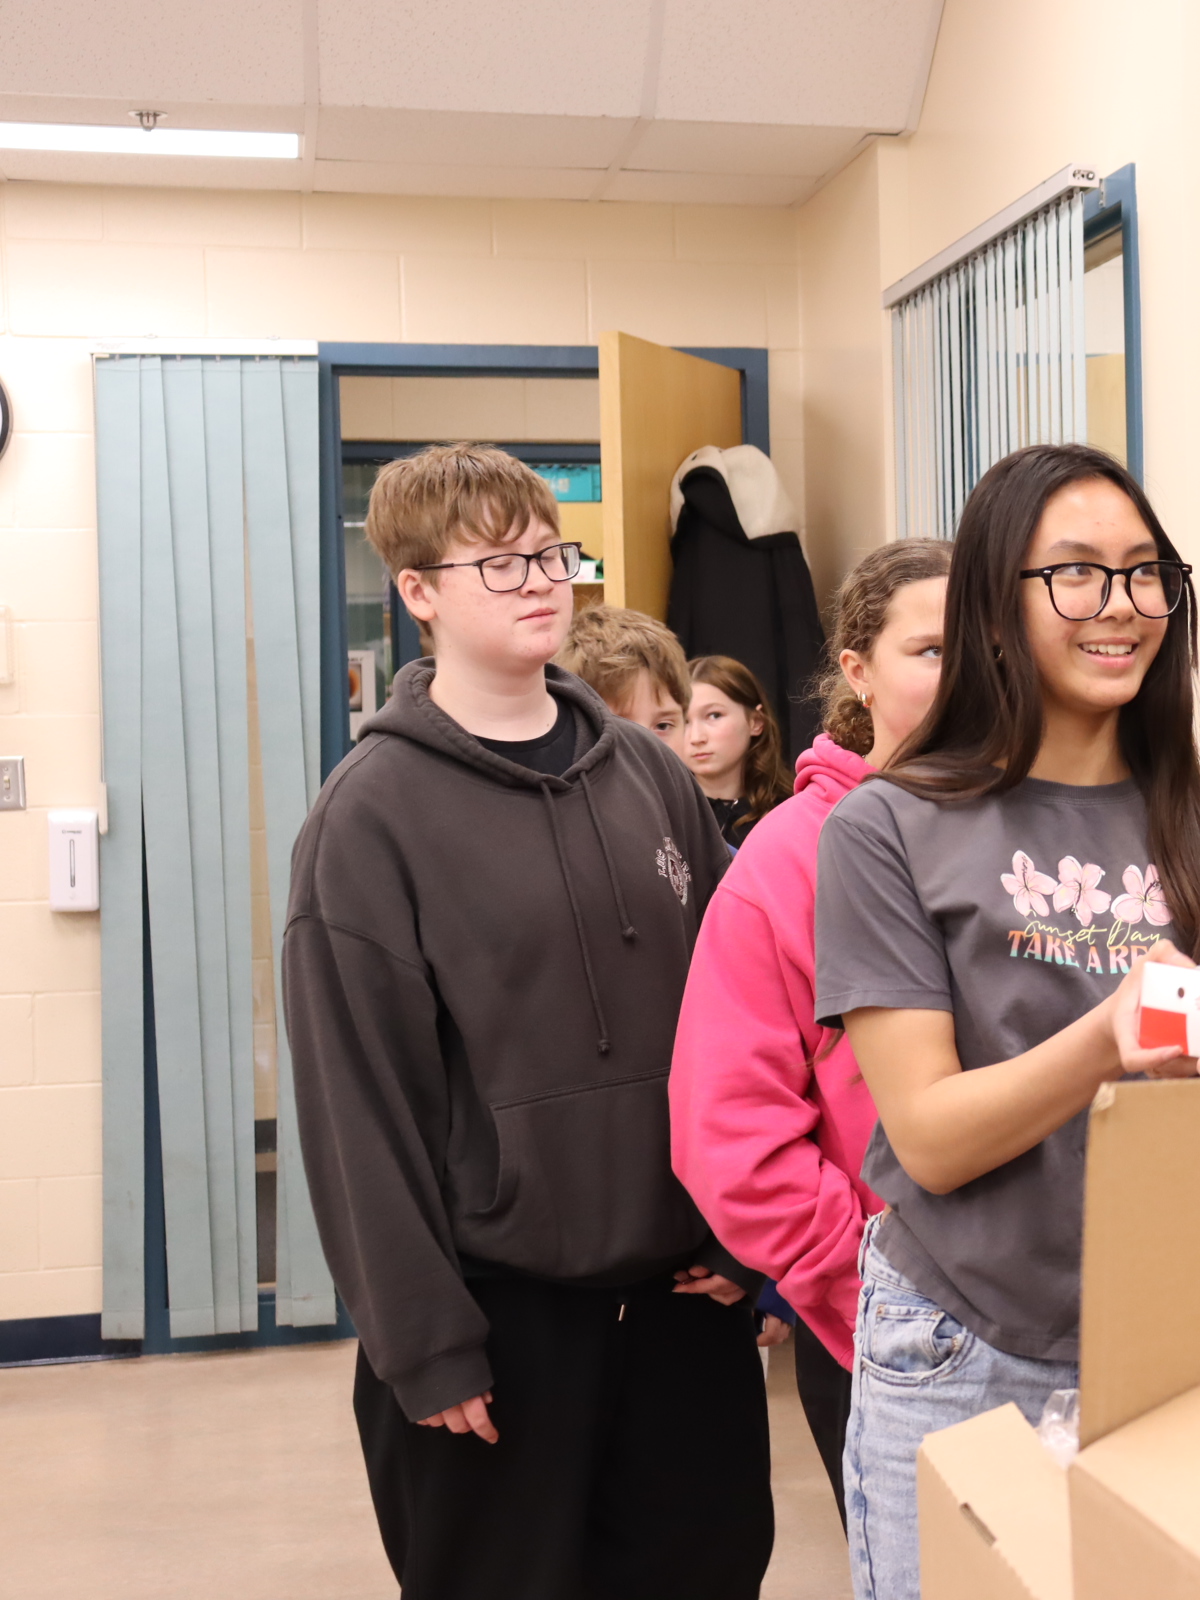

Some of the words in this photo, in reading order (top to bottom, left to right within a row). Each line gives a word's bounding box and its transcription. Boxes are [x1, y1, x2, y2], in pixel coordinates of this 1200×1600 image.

[1023, 910, 1107, 946] Sunset
[1007, 930, 1080, 968] TAKE
[1085, 946, 1104, 974] A
